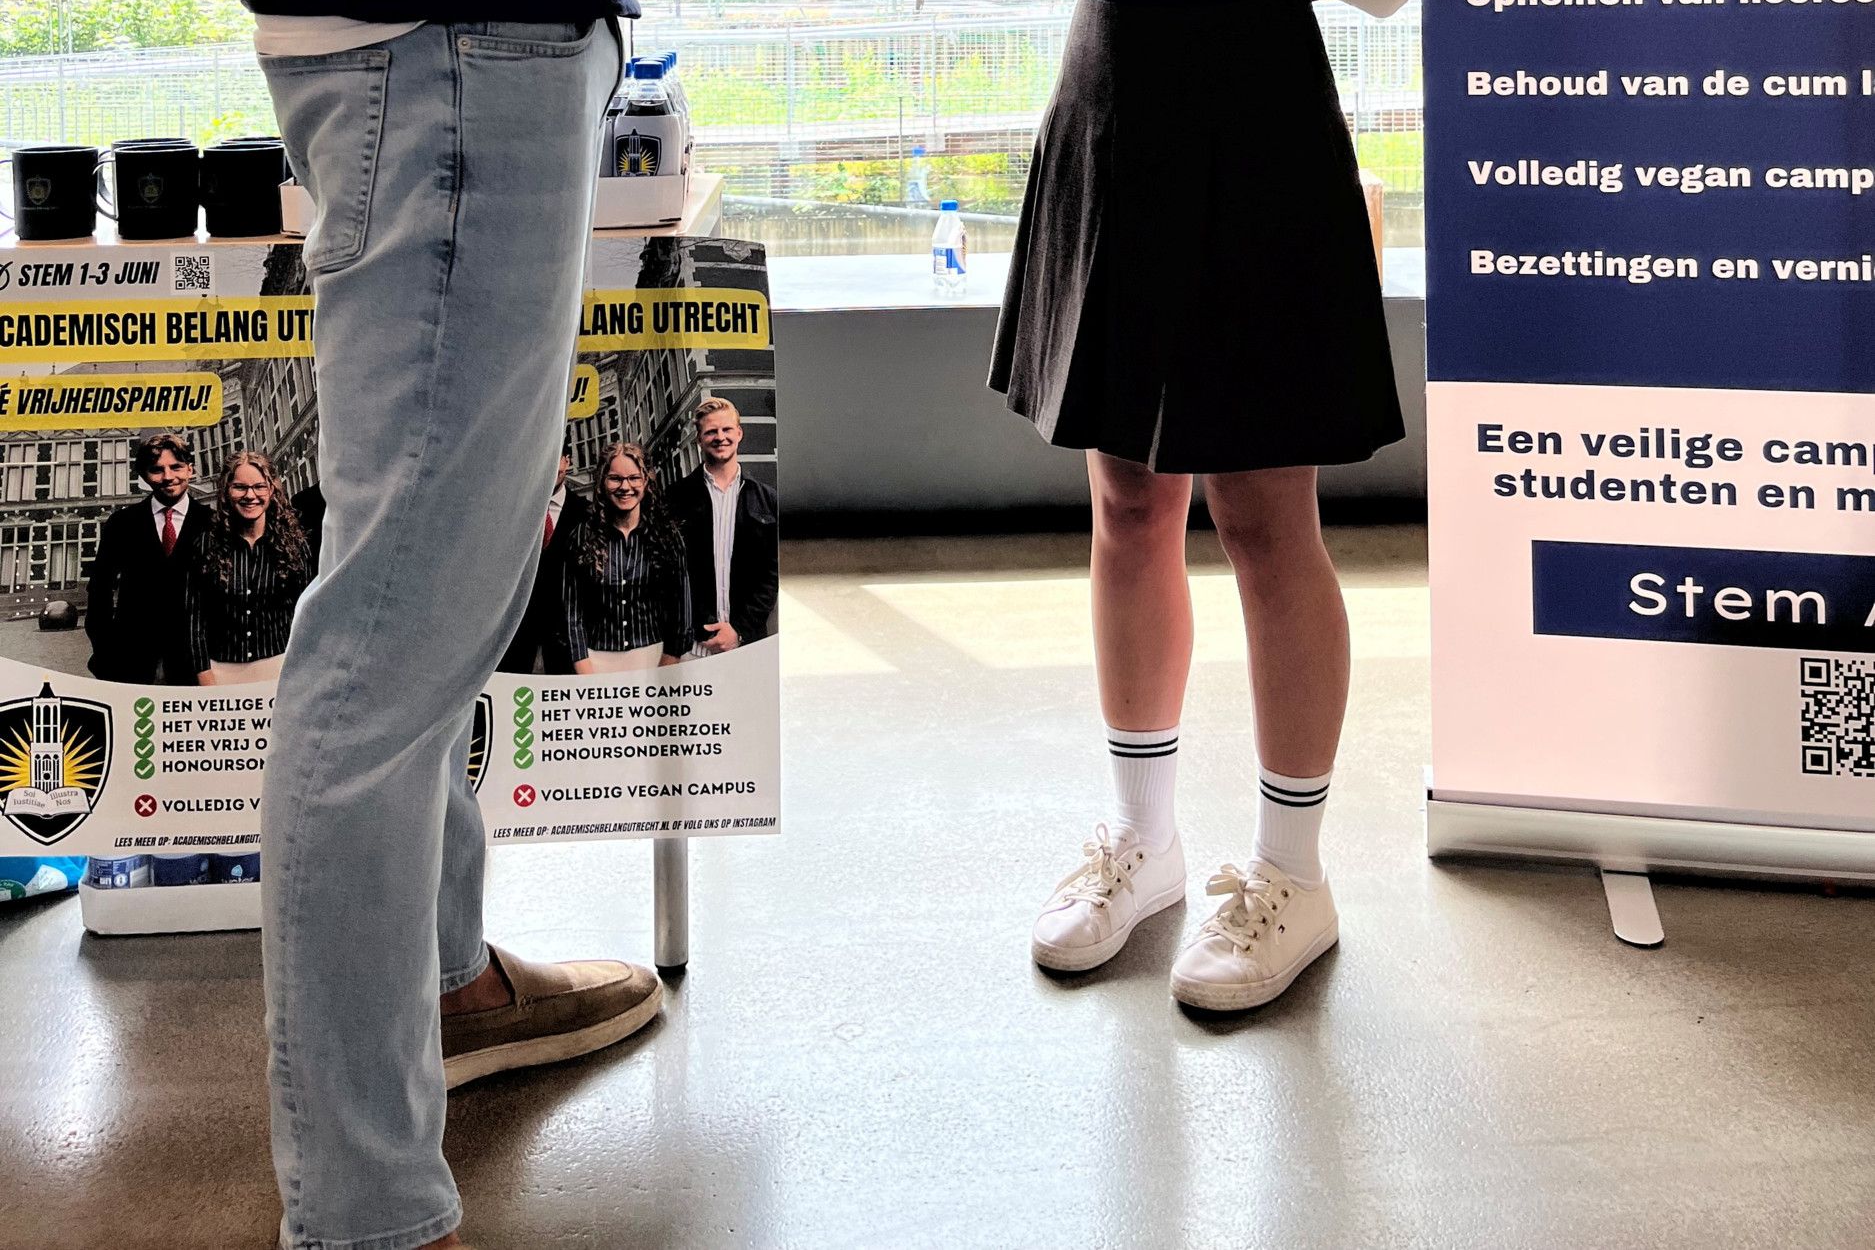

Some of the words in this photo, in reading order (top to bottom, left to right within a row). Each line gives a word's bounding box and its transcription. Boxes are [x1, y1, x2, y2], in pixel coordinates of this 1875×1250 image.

[1466, 70, 1608, 96] Behoud
[1621, 75, 1689, 96] van
[1702, 70, 1749, 96] de
[1763, 74, 1847, 96] cum
[1468, 160, 1623, 192] Volledig
[1634, 165, 1751, 193] vegan
[18, 263, 74, 287] STEM
[80, 262, 110, 285] 1-3
[114, 261, 160, 285] JUNI
[1469, 249, 1698, 283] Bezettingen
[1711, 257, 1759, 280] en
[1771, 254, 1875, 281] verni
[166, 309, 268, 344] BELANG
[652, 301, 760, 334] UTRECHT
[17, 385, 212, 415] VRIJHEIDSPARTIJ!
[1477, 423, 1562, 456] Een
[1581, 427, 1744, 469] veilige
[1762, 439, 1875, 475] cam
[1493, 467, 1737, 506] studenten
[1757, 484, 1815, 509] en
[1628, 572, 1827, 625] Stem
[541, 689, 571, 702] EEN
[576, 686, 640, 700] VEILIGE
[645, 685, 713, 698] CAMPUS
[162, 700, 192, 713] EEN
[198, 698, 263, 712] VEILIGE
[541, 709, 571, 721] HET
[575, 706, 623, 720] VRIJE
[629, 705, 691, 718] WOORD
[162, 720, 192, 733] HET
[197, 719, 246, 732] VRIJE
[541, 728, 583, 741] MEER
[589, 726, 627, 739] VRIJ
[632, 723, 731, 738] ONDERZOEK
[162, 739, 205, 753] MEER
[210, 738, 249, 751] VRIJ
[541, 743, 722, 761] HONOURSONDERWIJS
[541, 786, 622, 801] VOLLEDIG
[627, 783, 682, 798] VEGAN
[688, 781, 756, 795] CAMPUS
[162, 798, 244, 812] VOLLEDIG
[493, 828, 511, 838] LEES
[513, 826, 534, 837] MEER
[672, 820, 682, 830] OF
[683, 819, 702, 830] VOLG
[704, 818, 719, 829] ONS
[721, 818, 731, 828] OP
[732, 816, 776, 828] INSTAGRAM
[114, 837, 132, 847] LEES
[134, 836, 156, 847] MEER
[158, 836, 171, 846] OP:
[173, 834, 261, 846] ACADEMISCHBELANGUT
